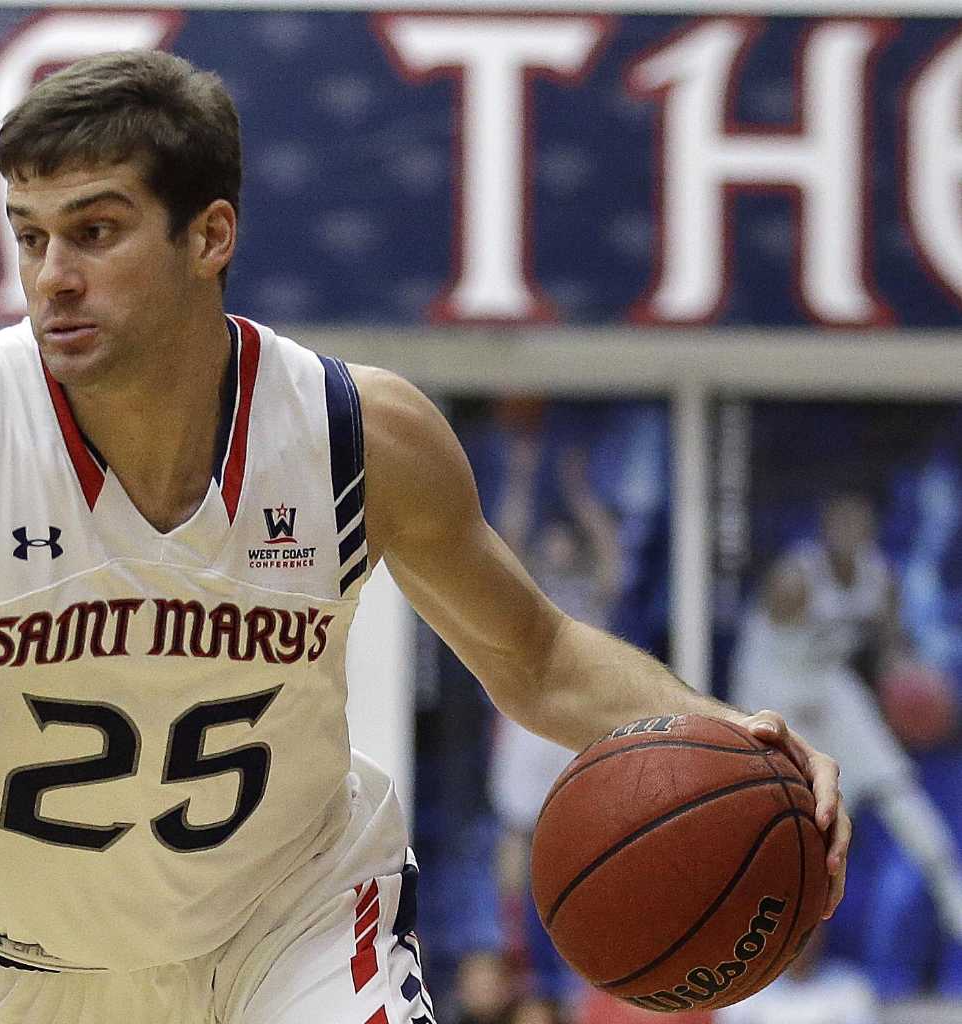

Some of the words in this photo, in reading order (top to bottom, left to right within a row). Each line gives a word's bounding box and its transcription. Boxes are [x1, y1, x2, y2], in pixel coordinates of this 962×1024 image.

[248, 549, 280, 560] WEST
[282, 547, 316, 560] COAST
[249, 559, 314, 569] CONFERENCE
[146, 598, 336, 665] MARY'S
